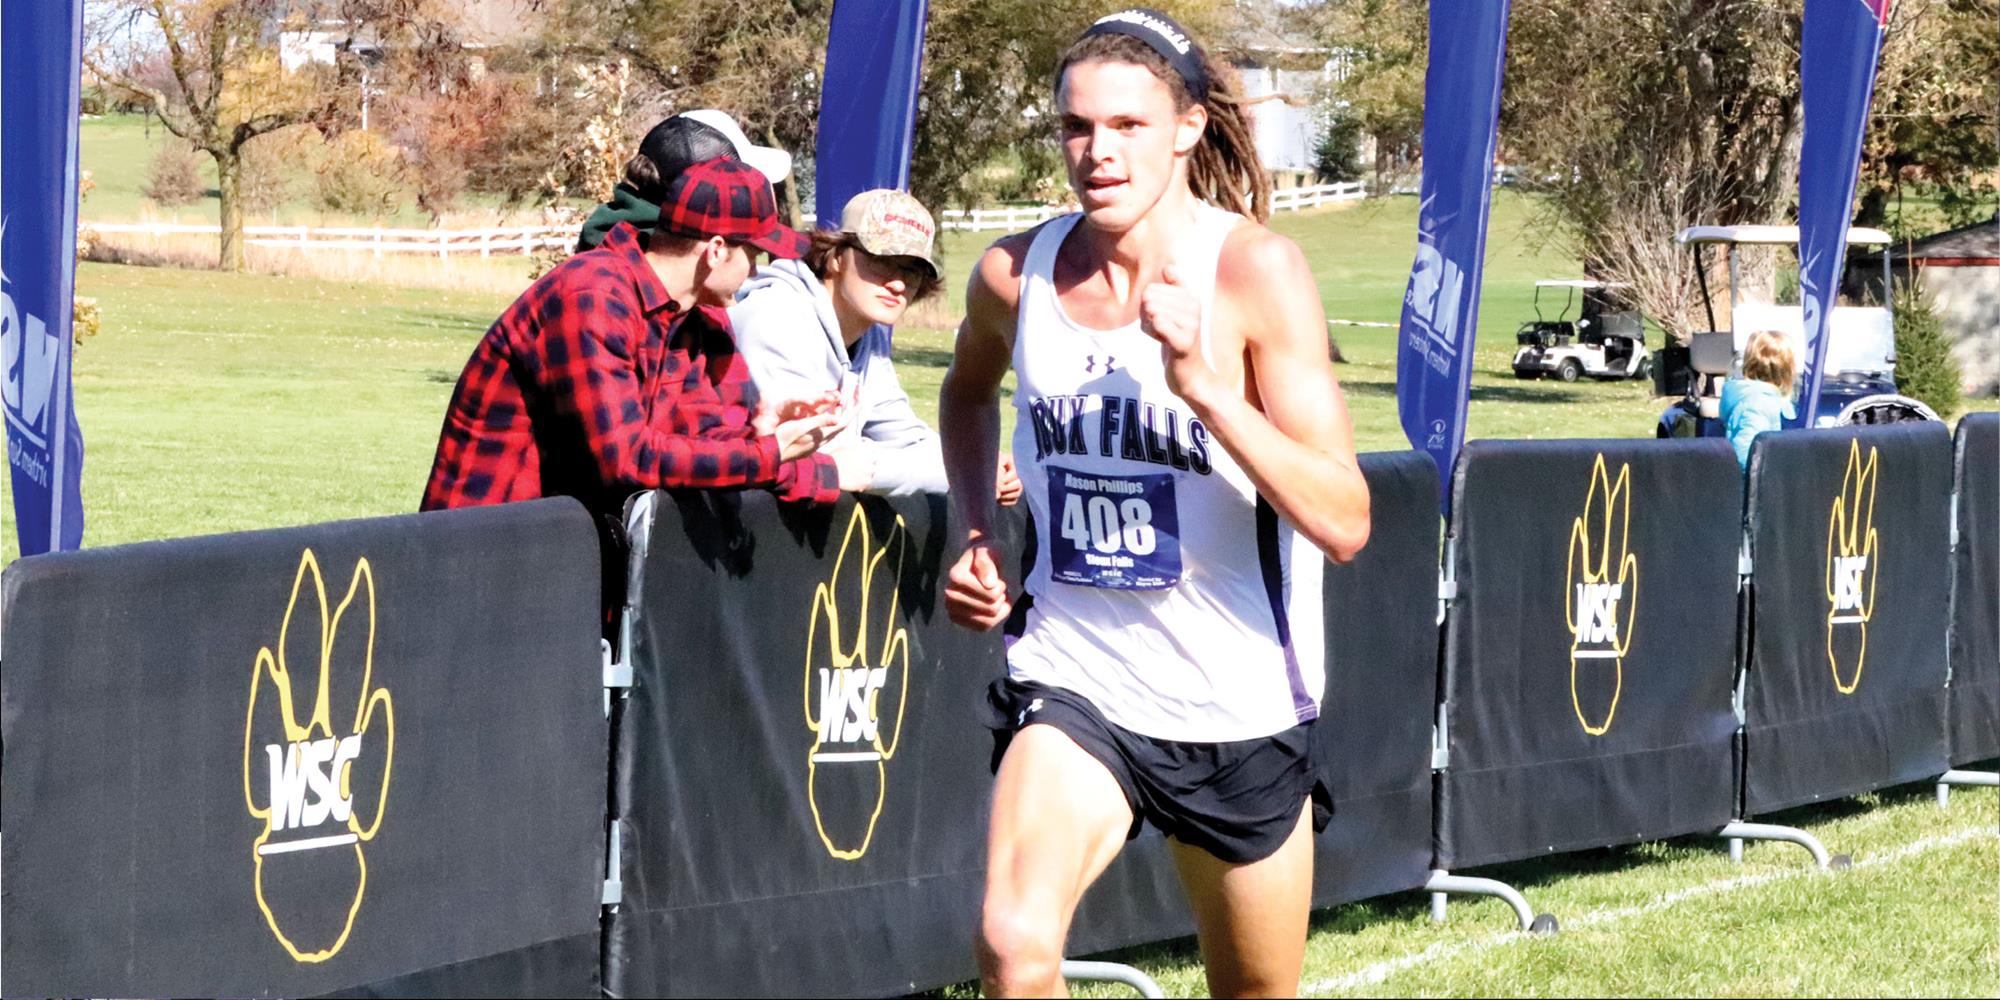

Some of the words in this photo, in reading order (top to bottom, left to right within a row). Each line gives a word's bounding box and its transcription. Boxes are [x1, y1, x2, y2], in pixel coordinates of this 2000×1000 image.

[1100, 396, 1212, 475] FALLS
[1098, 479, 1144, 494] Phillips
[1061, 493, 1156, 556] 408
[1085, 554, 1111, 566] Sioux
[1112, 555, 1134, 568] Falls
[1833, 555, 1867, 609] WSC
[1576, 582, 1623, 643] WSC
[819, 666, 888, 743] WSC
[265, 730, 362, 831] WSC
